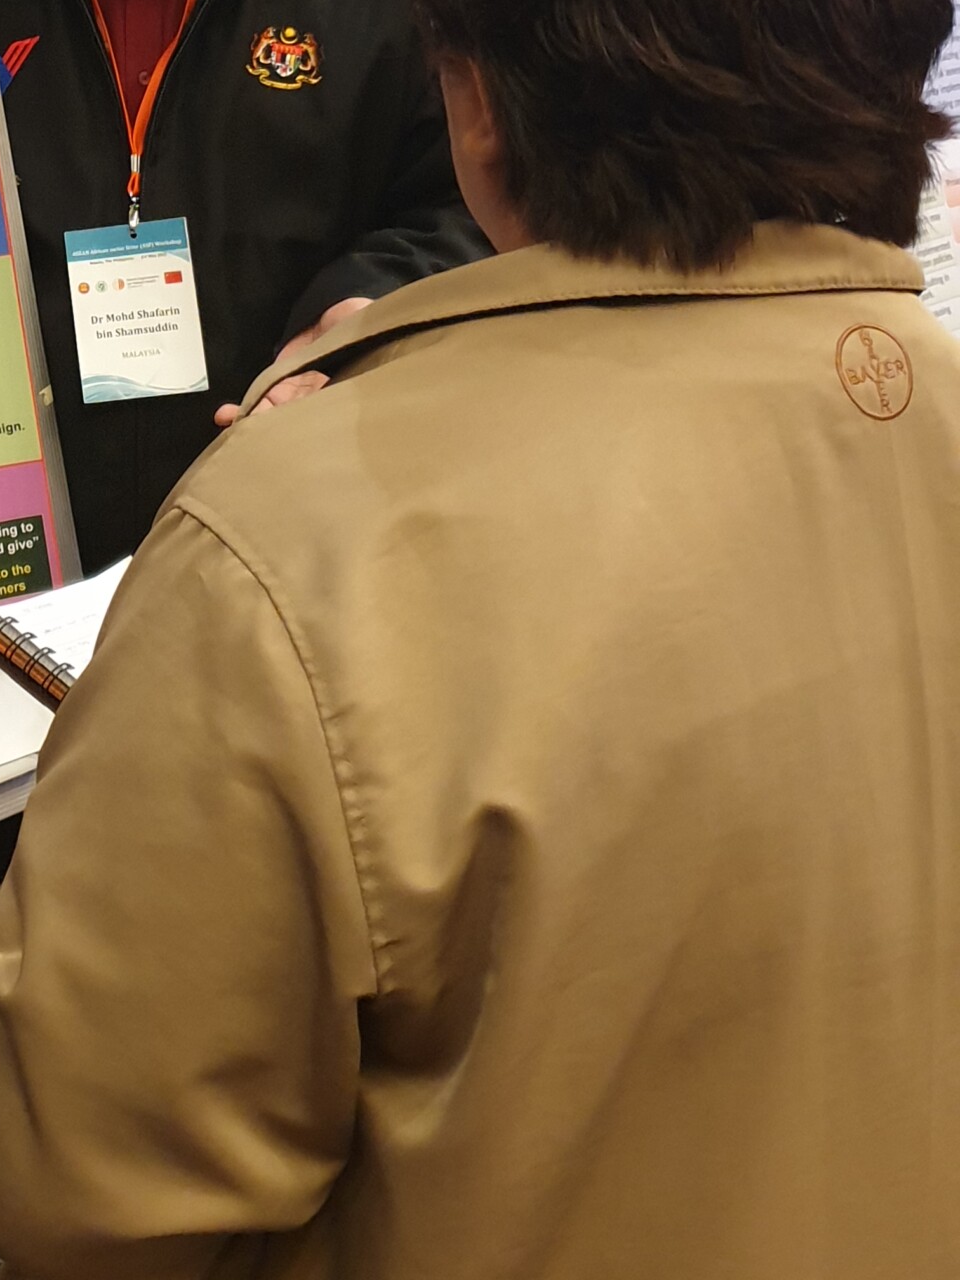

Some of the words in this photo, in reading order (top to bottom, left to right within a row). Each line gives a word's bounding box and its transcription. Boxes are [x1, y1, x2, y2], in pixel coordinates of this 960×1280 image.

[91, 316, 103, 324] Dr
[106, 311, 134, 322] Mohd
[137, 306, 180, 320] Shafarin
[97, 330, 112, 339] bin
[115, 323, 178, 337] Shamsuddin
[122, 349, 160, 359] MALAYSIA
[20, 522, 33, 534] to
[11, 563, 32, 576] the
